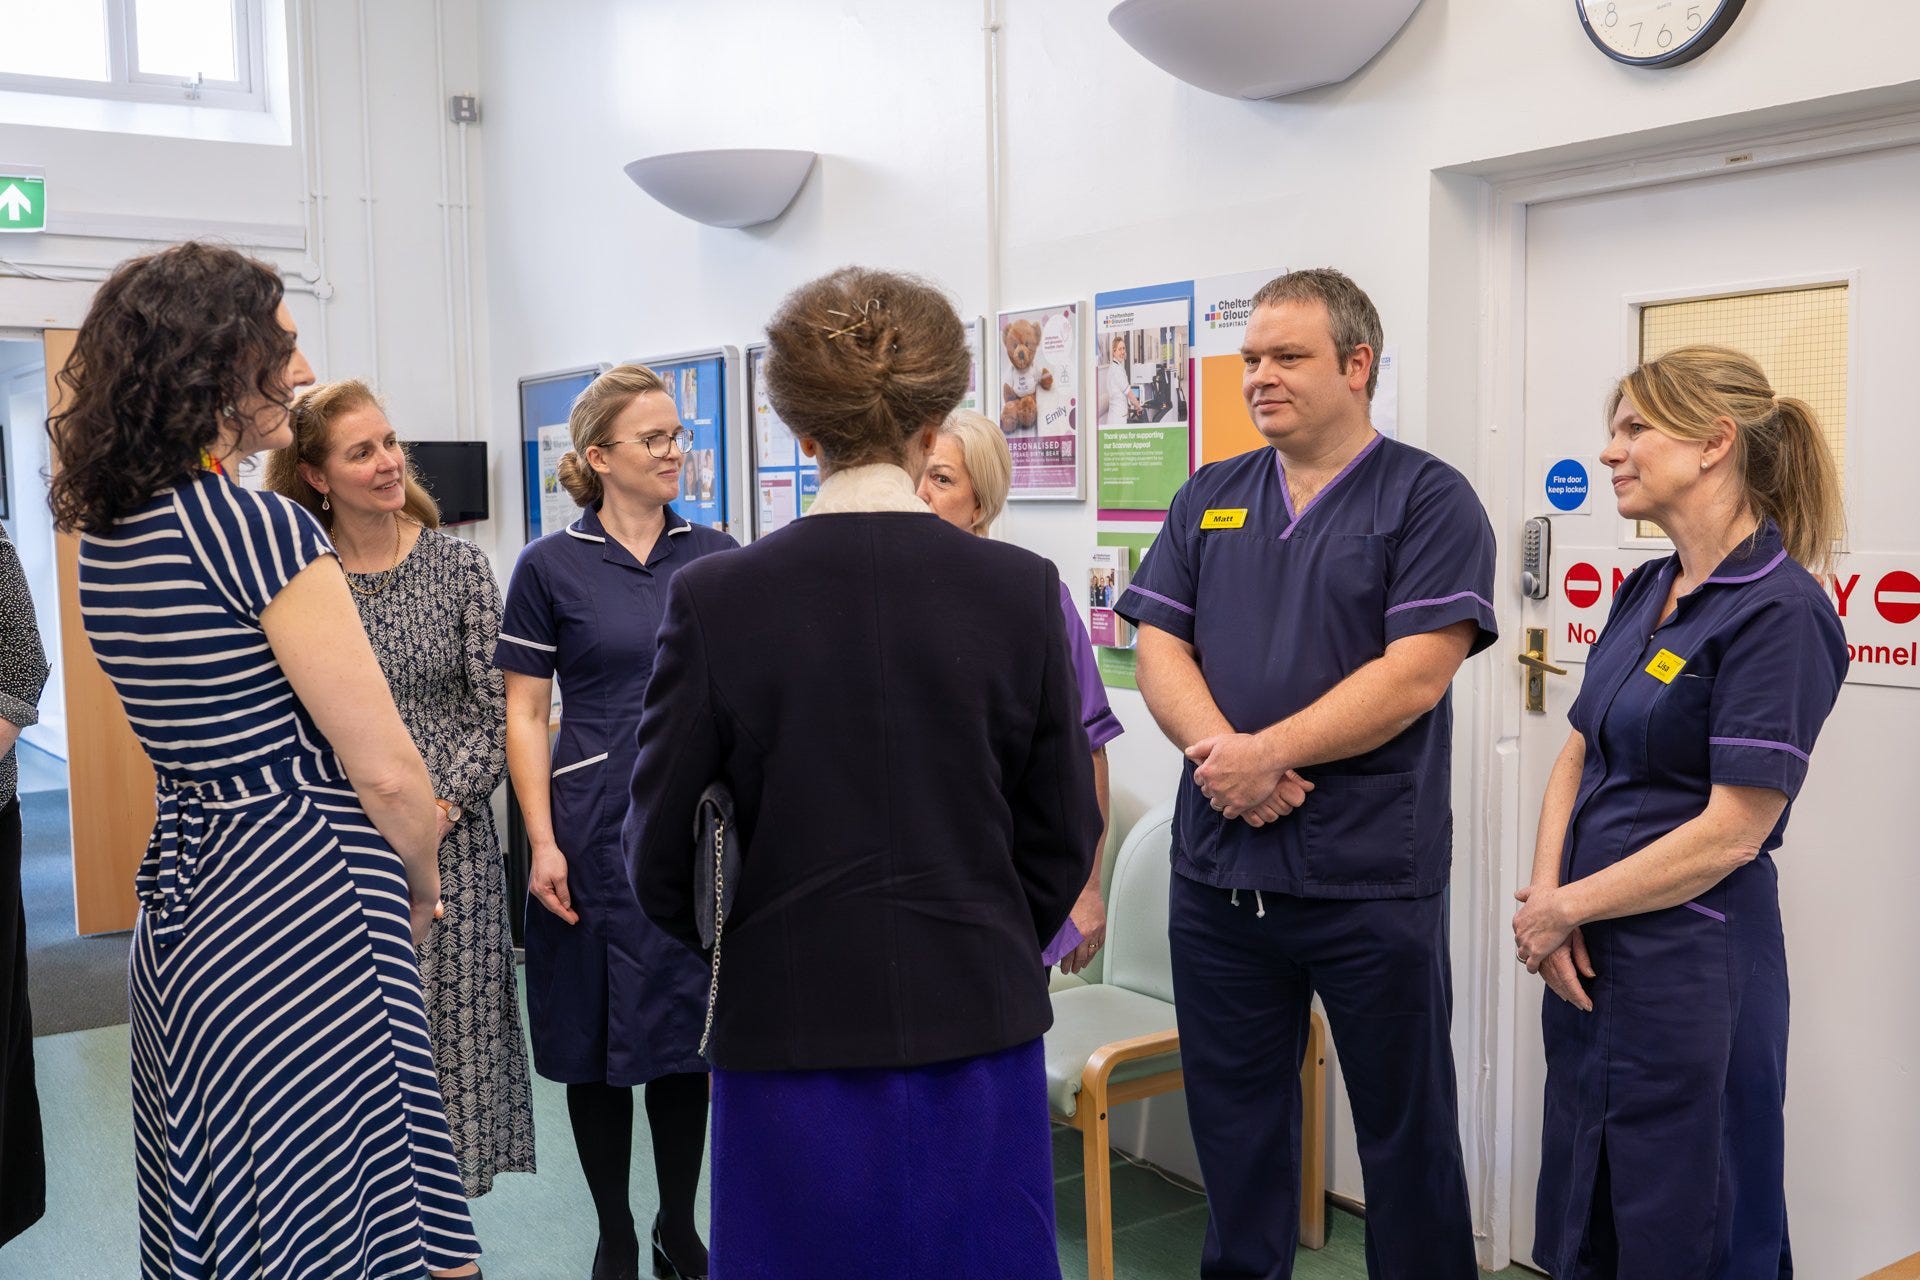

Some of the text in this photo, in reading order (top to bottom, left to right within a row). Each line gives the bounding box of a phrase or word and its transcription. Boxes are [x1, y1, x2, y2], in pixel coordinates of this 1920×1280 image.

[1605, 2, 1618, 27] 8
[1686, 5, 1701, 31] 5
[1629, 22, 1643, 47] 7
[1657, 23, 1672, 48] 6
[1222, 310, 1250, 321] Glouc
[1045, 406, 1067, 425] Emily
[1128, 431, 1136, 439] for
[1136, 431, 1164, 440] supporting
[1008, 440, 1060, 451] ERSONALISED
[1133, 441, 1151, 450] Appeal
[1553, 475, 1582, 483] Fire door
[1548, 486, 1565, 494] keep
[1213, 515, 1234, 523] Matt
[1567, 622, 1918, 666] No onnel
[1657, 660, 1671, 673] Lisa
